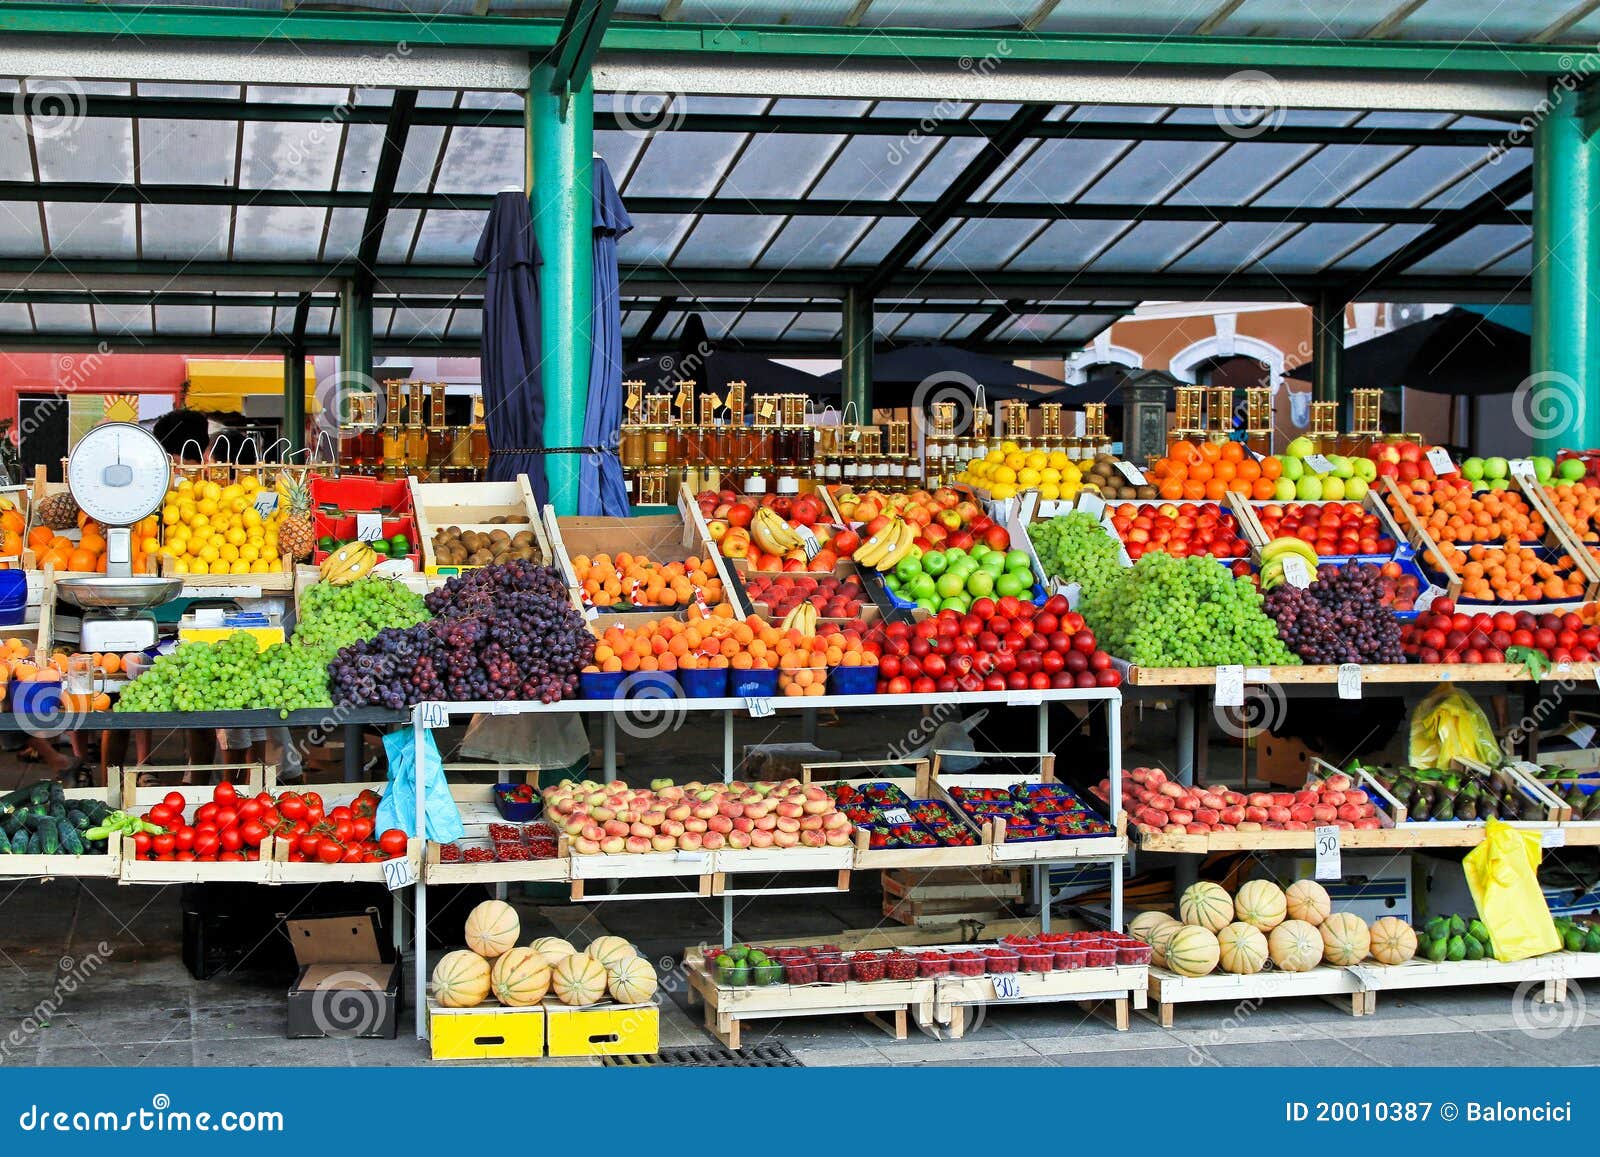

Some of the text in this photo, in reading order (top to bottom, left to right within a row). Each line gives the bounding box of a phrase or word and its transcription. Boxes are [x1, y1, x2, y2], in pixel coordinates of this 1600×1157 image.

[423, 703, 442, 728] 40
[1319, 836, 1337, 856] 50
[385, 862, 407, 889] 20
[992, 977, 1012, 998] 30
